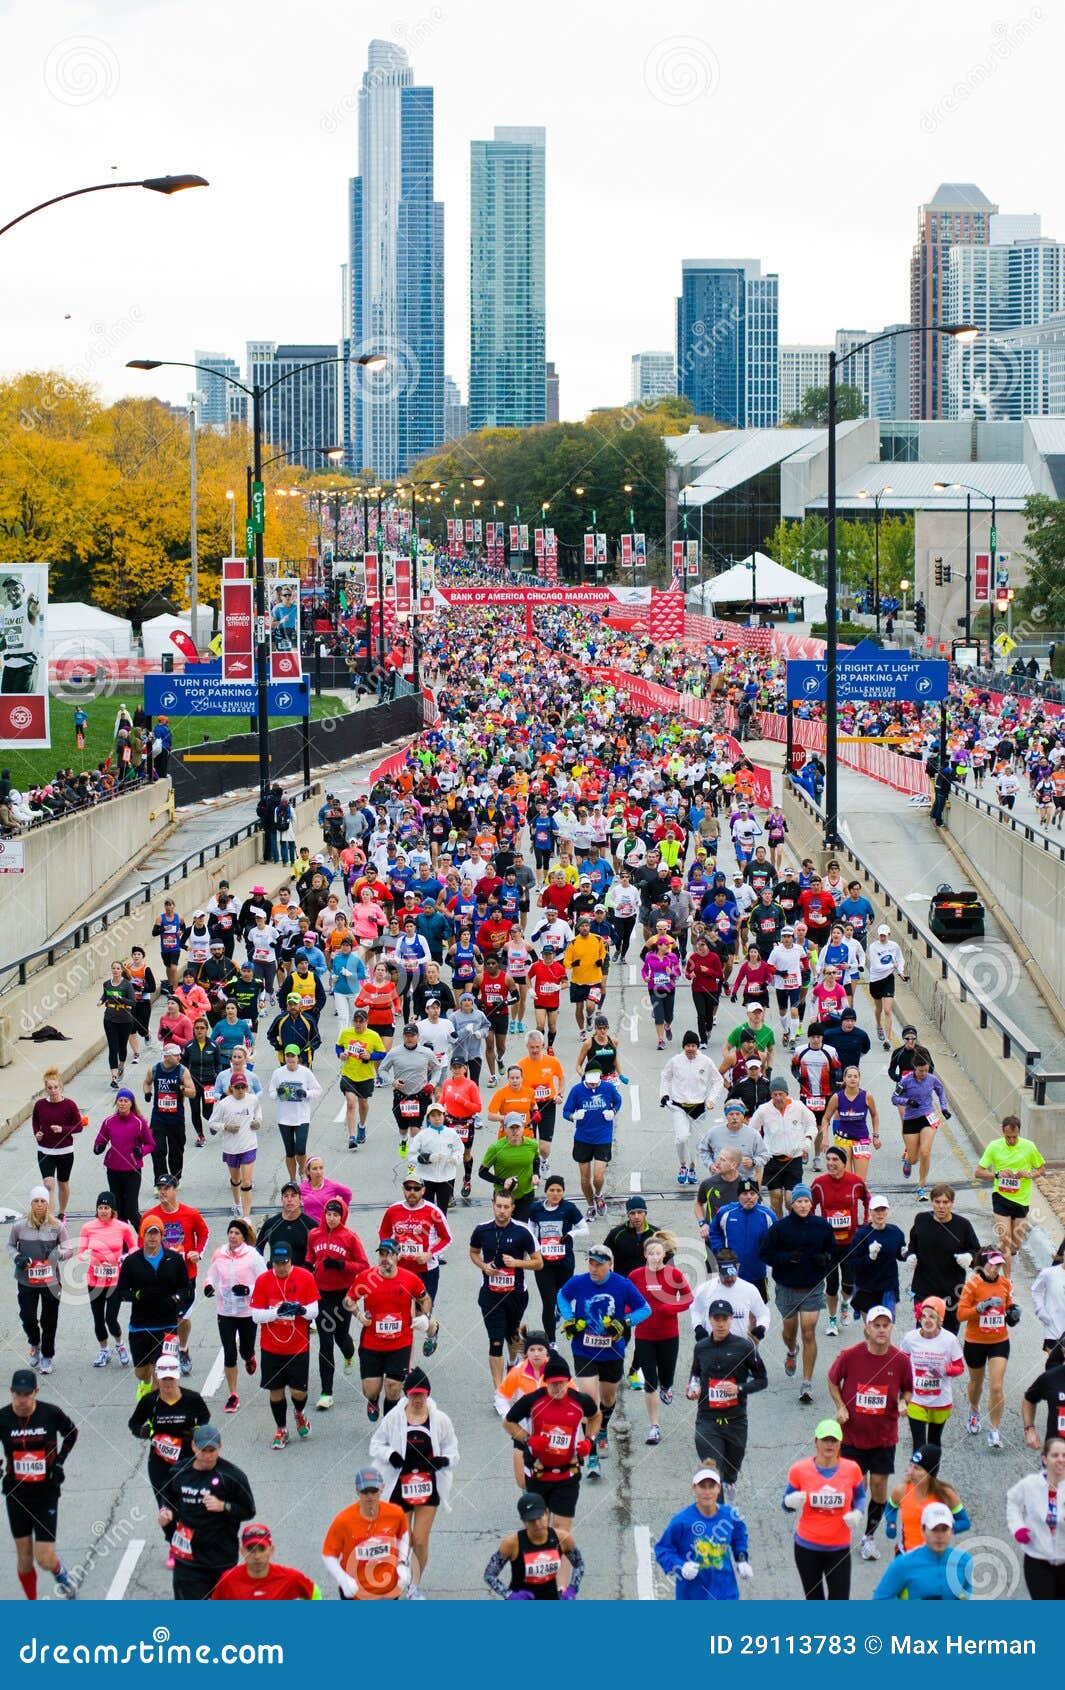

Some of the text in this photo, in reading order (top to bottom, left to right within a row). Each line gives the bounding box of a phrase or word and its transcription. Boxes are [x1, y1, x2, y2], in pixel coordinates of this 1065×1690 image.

[792, 752, 805, 761] TOP
[11, 1428, 47, 1437] MANUEL
[180, 1486, 199, 1496] Why
[812, 1496, 817, 1504] D
